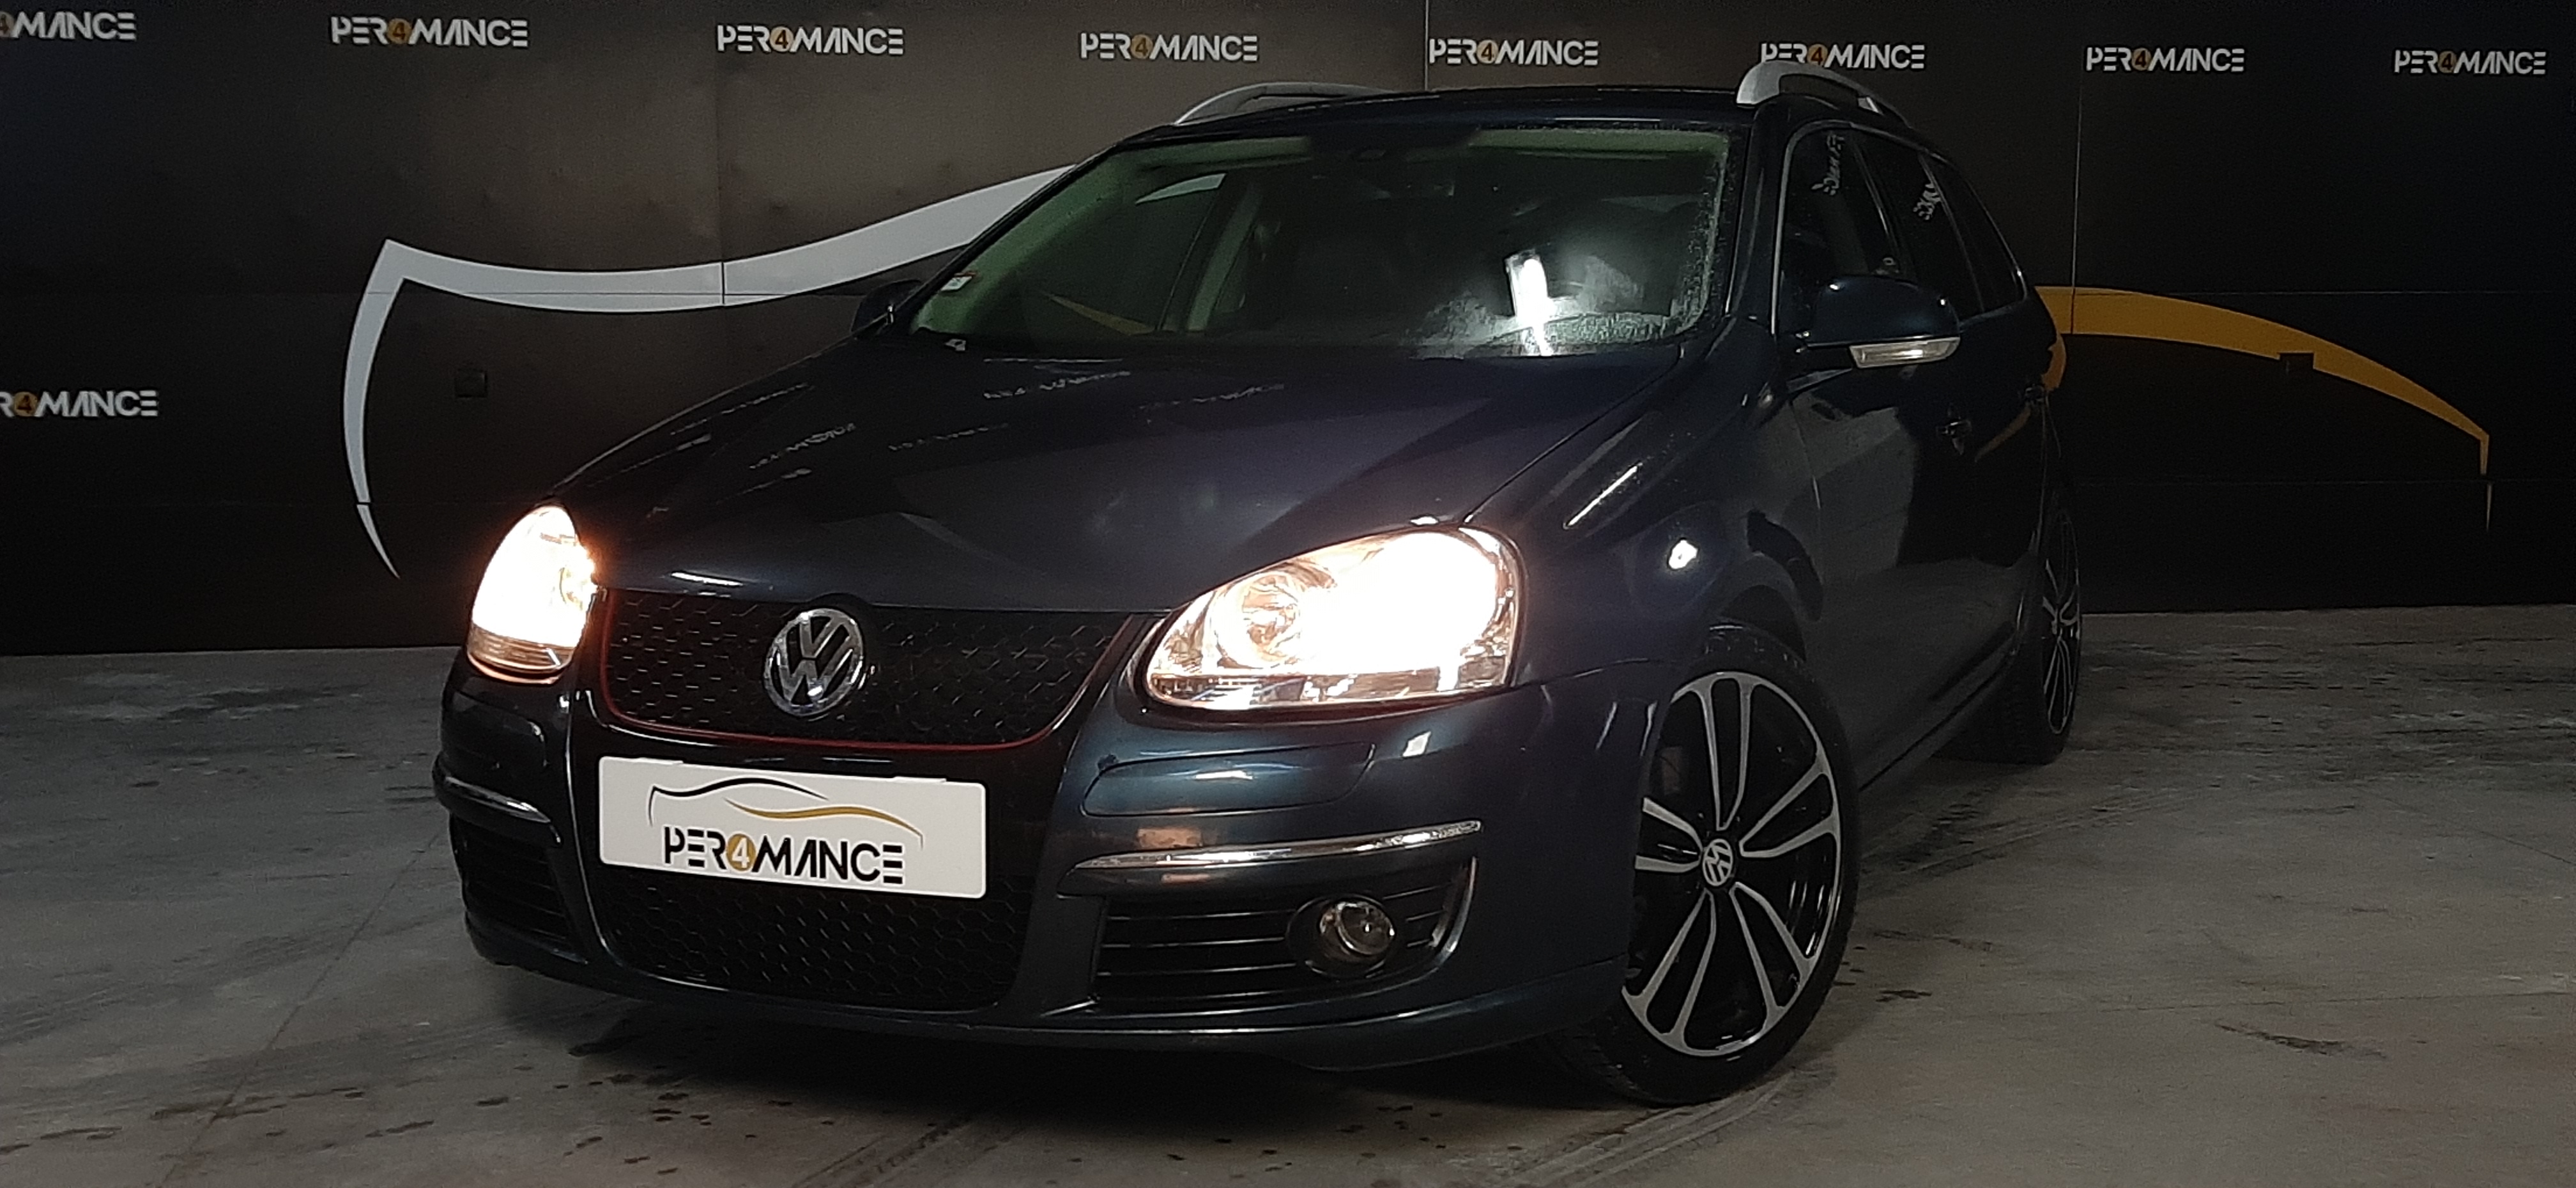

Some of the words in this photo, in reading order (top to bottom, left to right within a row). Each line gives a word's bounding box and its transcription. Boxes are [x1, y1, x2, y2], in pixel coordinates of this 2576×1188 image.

[331, 17, 528, 47] PER4MANCE
[717, 25, 903, 54] PER4MANCE
[1080, 33, 1257, 61] PER4MANCE
[1429, 38, 1598, 65] PER4MANCE
[2086, 47, 2244, 72] PER4MANCE
[2395, 50, 2546, 75] PER4MANCE
[664, 826, 903, 885] PER4MANCE
